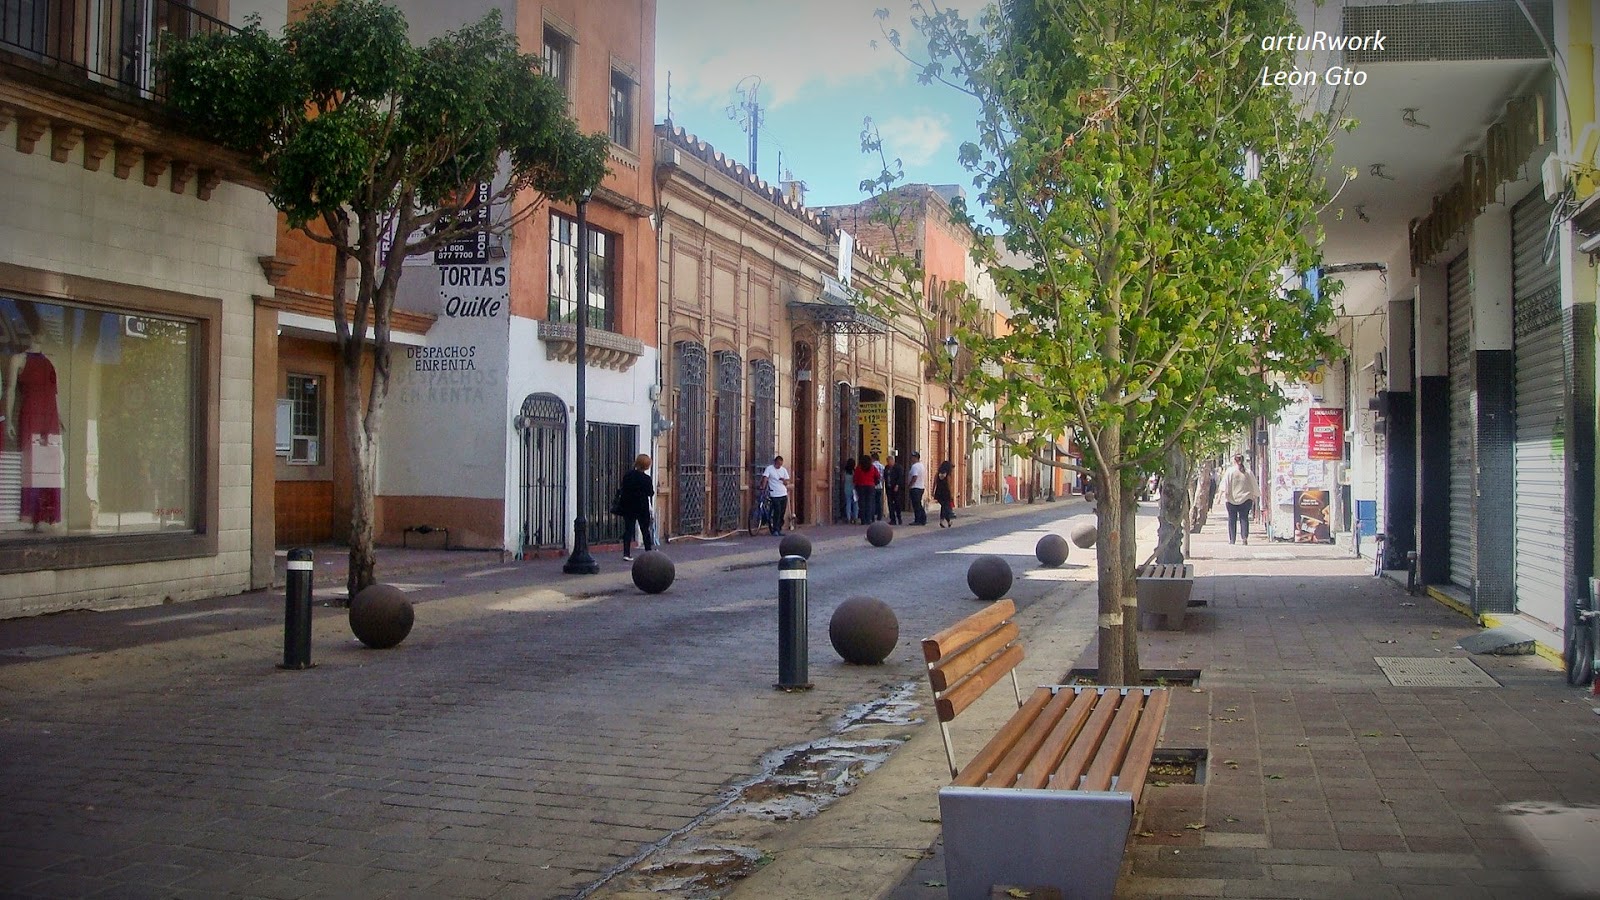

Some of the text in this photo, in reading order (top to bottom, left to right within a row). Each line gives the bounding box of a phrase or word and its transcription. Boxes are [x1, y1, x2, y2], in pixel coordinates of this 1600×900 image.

[449, 244, 464, 252] 800
[439, 266, 506, 287] TORTAS
[407, 345, 476, 359] DESPACHOS
